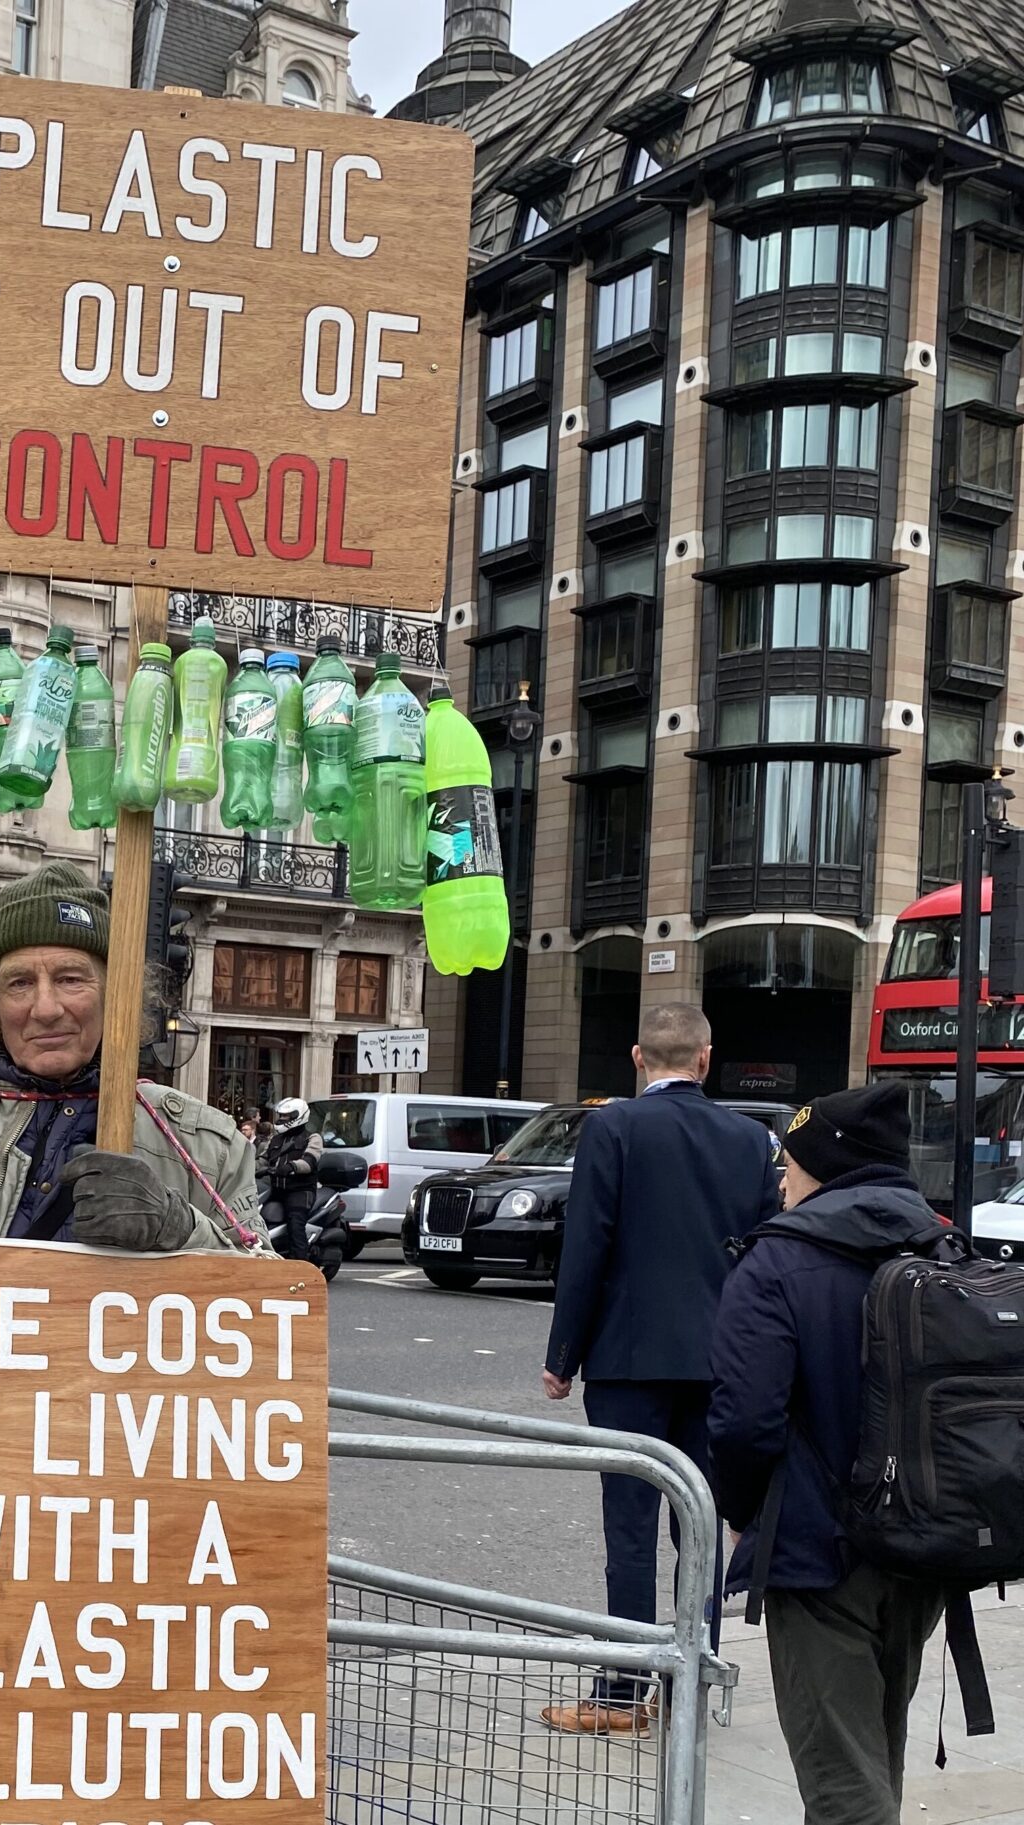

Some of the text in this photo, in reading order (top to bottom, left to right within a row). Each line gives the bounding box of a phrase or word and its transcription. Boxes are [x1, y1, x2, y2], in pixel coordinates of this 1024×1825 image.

[60, 280, 245, 400] OUT
[301, 305, 421, 416] OF
[38, 675, 73, 699] aloe
[142, 689, 166, 775] Lucozade
[900, 1021, 941, 1036] Oxford
[739, 1079, 777, 1089] express
[423, 1237, 457, 1250] LF21 CFU
[88, 1291, 310, 1382] COST
[32, 1391, 304, 1482] LIVING
[187, 1500, 238, 1586] A
